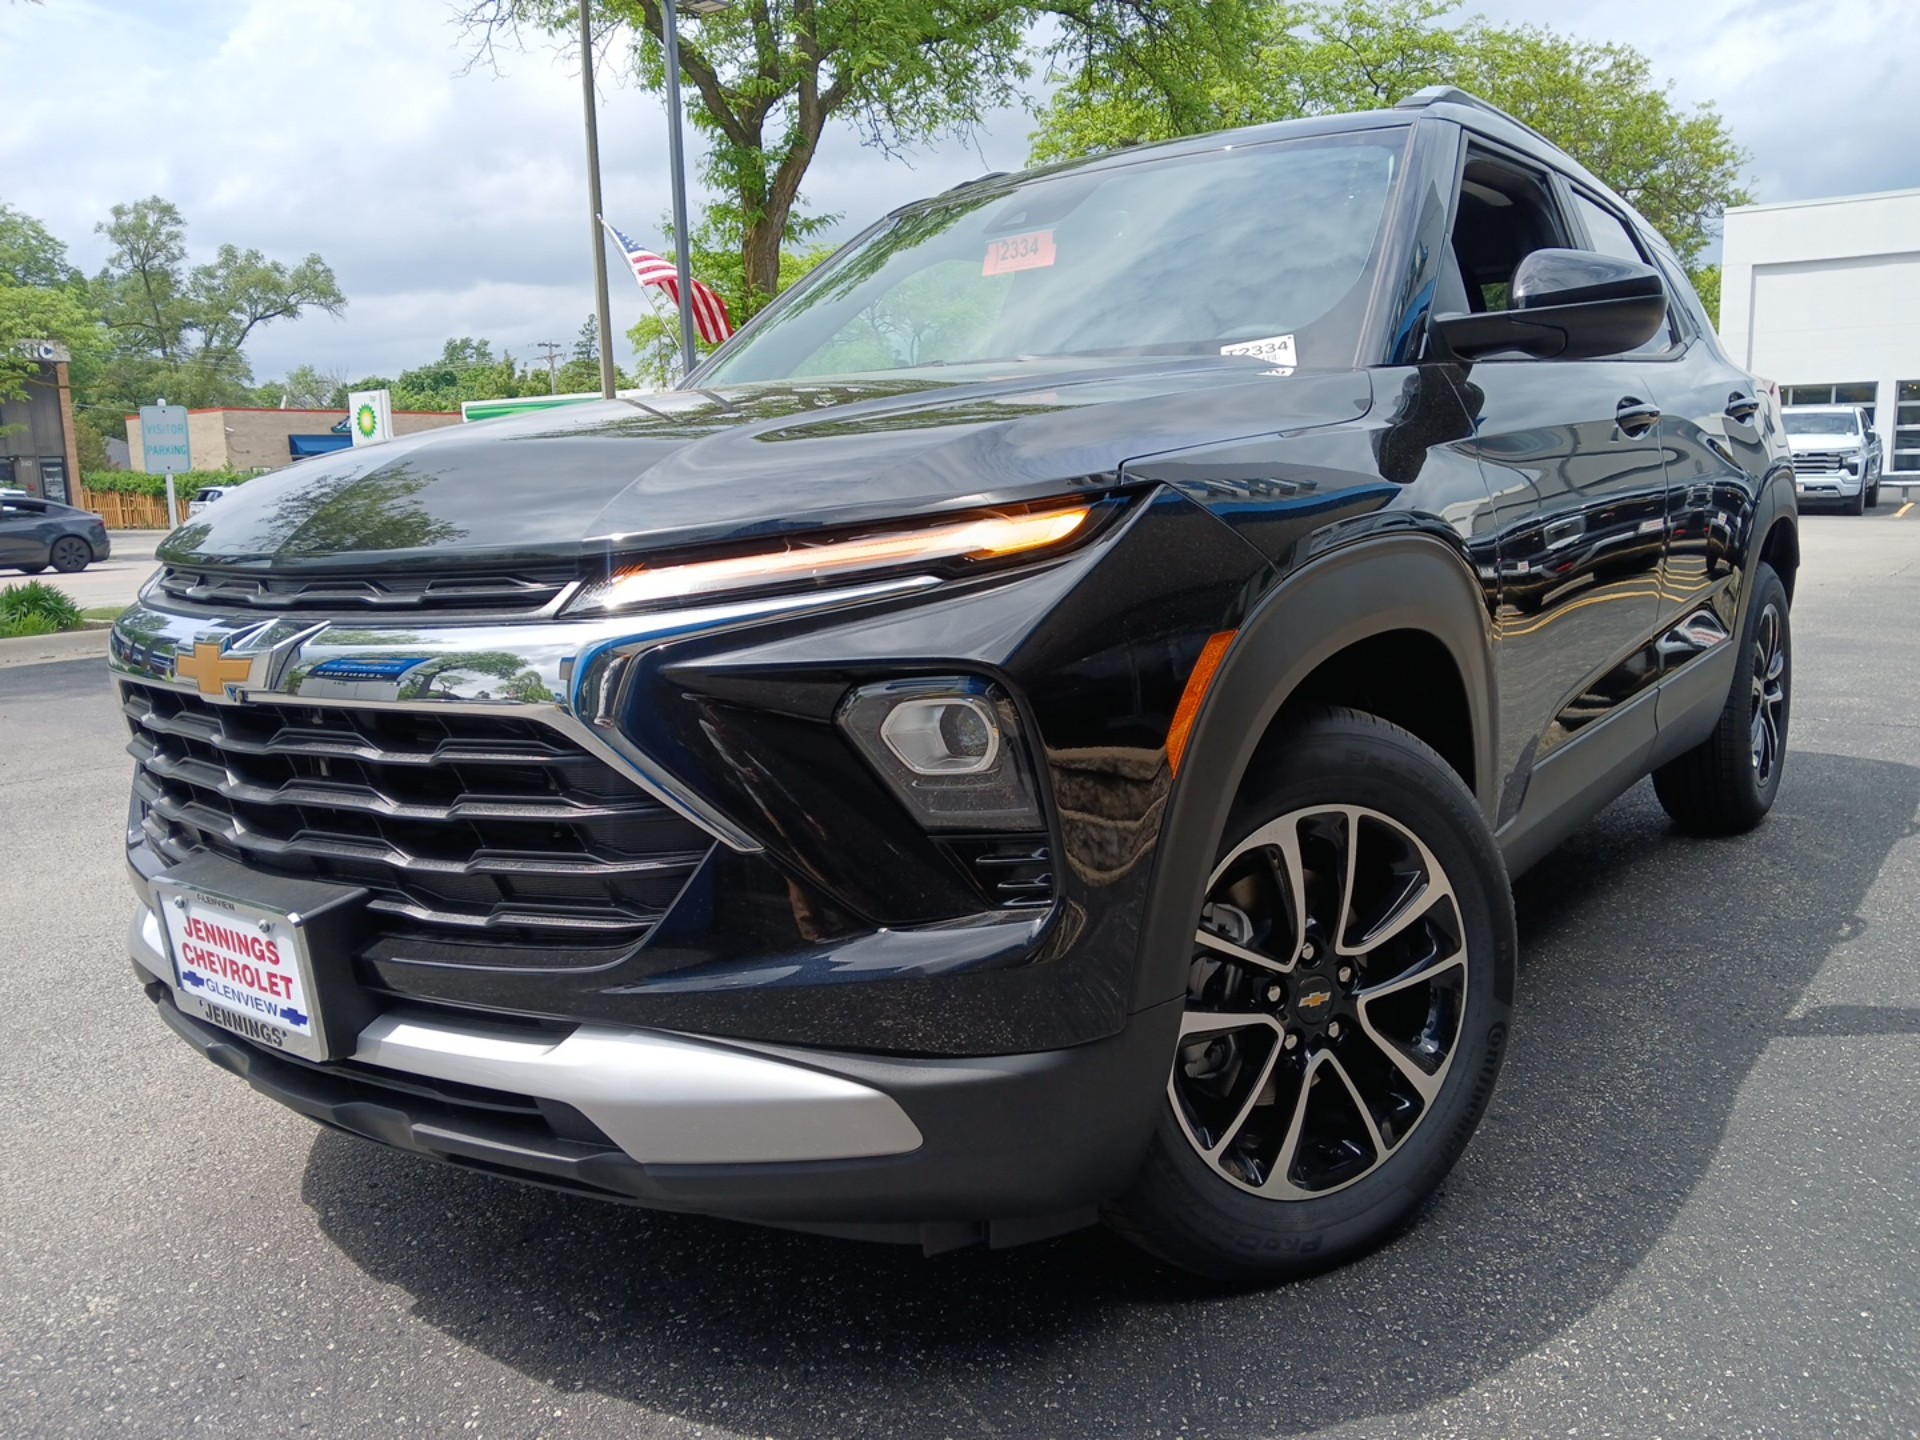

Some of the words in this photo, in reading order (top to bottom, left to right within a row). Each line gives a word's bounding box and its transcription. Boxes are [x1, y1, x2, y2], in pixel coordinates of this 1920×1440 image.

[146, 423, 185, 436] VISITOR
[146, 444, 188, 456] PARKING
[183, 916, 281, 966] JENNINGS
[182, 942, 293, 1000] CHEVROLET
[206, 978, 278, 1017] GLENVIEW
[205, 1004, 284, 1048] JENNINGS
